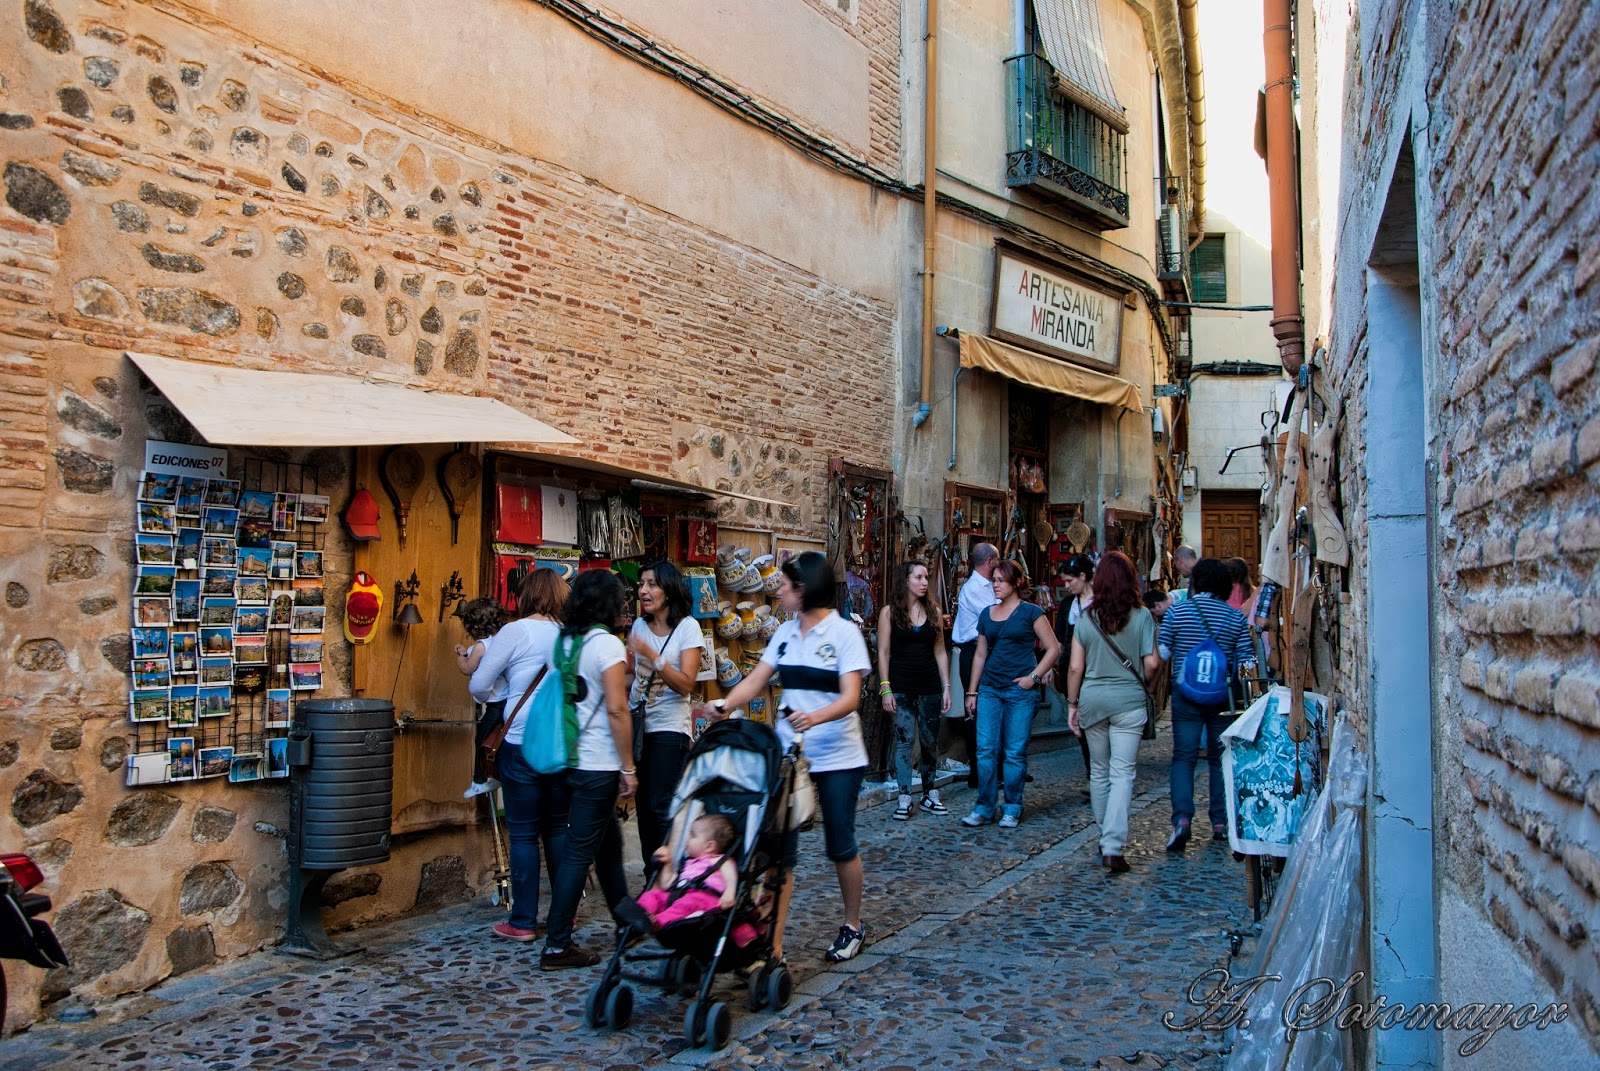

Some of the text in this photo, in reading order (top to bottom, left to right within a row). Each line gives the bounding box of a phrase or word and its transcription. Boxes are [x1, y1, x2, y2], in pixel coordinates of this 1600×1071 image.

[1018, 269, 1104, 324] ARTESANIA
[1030, 304, 1095, 351] MIRANDA
[151, 454, 224, 469] EDICIONES 07
